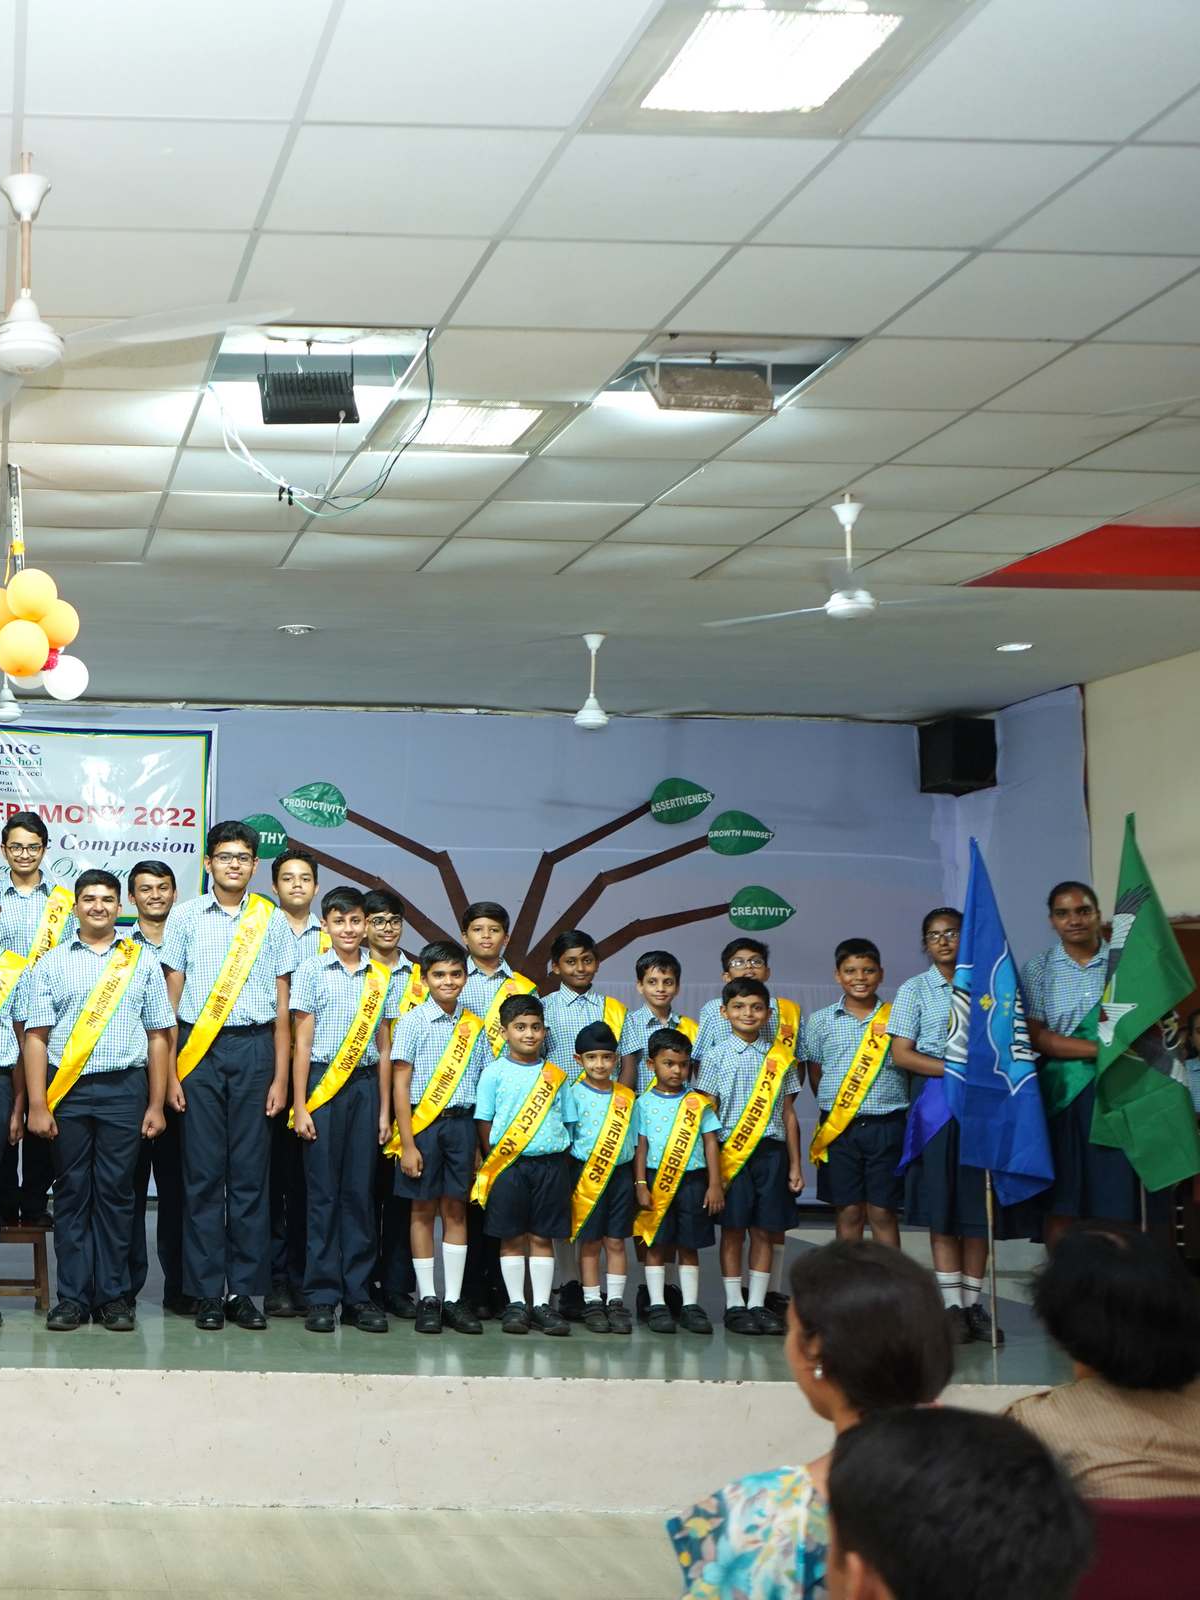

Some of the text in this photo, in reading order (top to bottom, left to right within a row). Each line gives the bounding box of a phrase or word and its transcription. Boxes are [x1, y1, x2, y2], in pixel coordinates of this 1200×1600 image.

[283, 798, 346, 815] PRODUCTIVITY
[651, 792, 712, 814] ASSERTIVENESS
[134, 806, 196, 827] 2022
[61, 833, 196, 857] Compassion
[708, 829, 774, 840] GROWTH MINDSET
[730, 906, 791, 917] CREATIVITY
[427, 1066, 455, 1106] PRIMARY
[838, 1053, 873, 1110] MEMBER
[517, 1080, 554, 1133] PREFECT
[730, 1095, 767, 1152] MEMBER
[498, 1137, 516, 1158] KG
[587, 1119, 624, 1183] MEMBERS
[657, 1128, 691, 1193] MEMBERS
